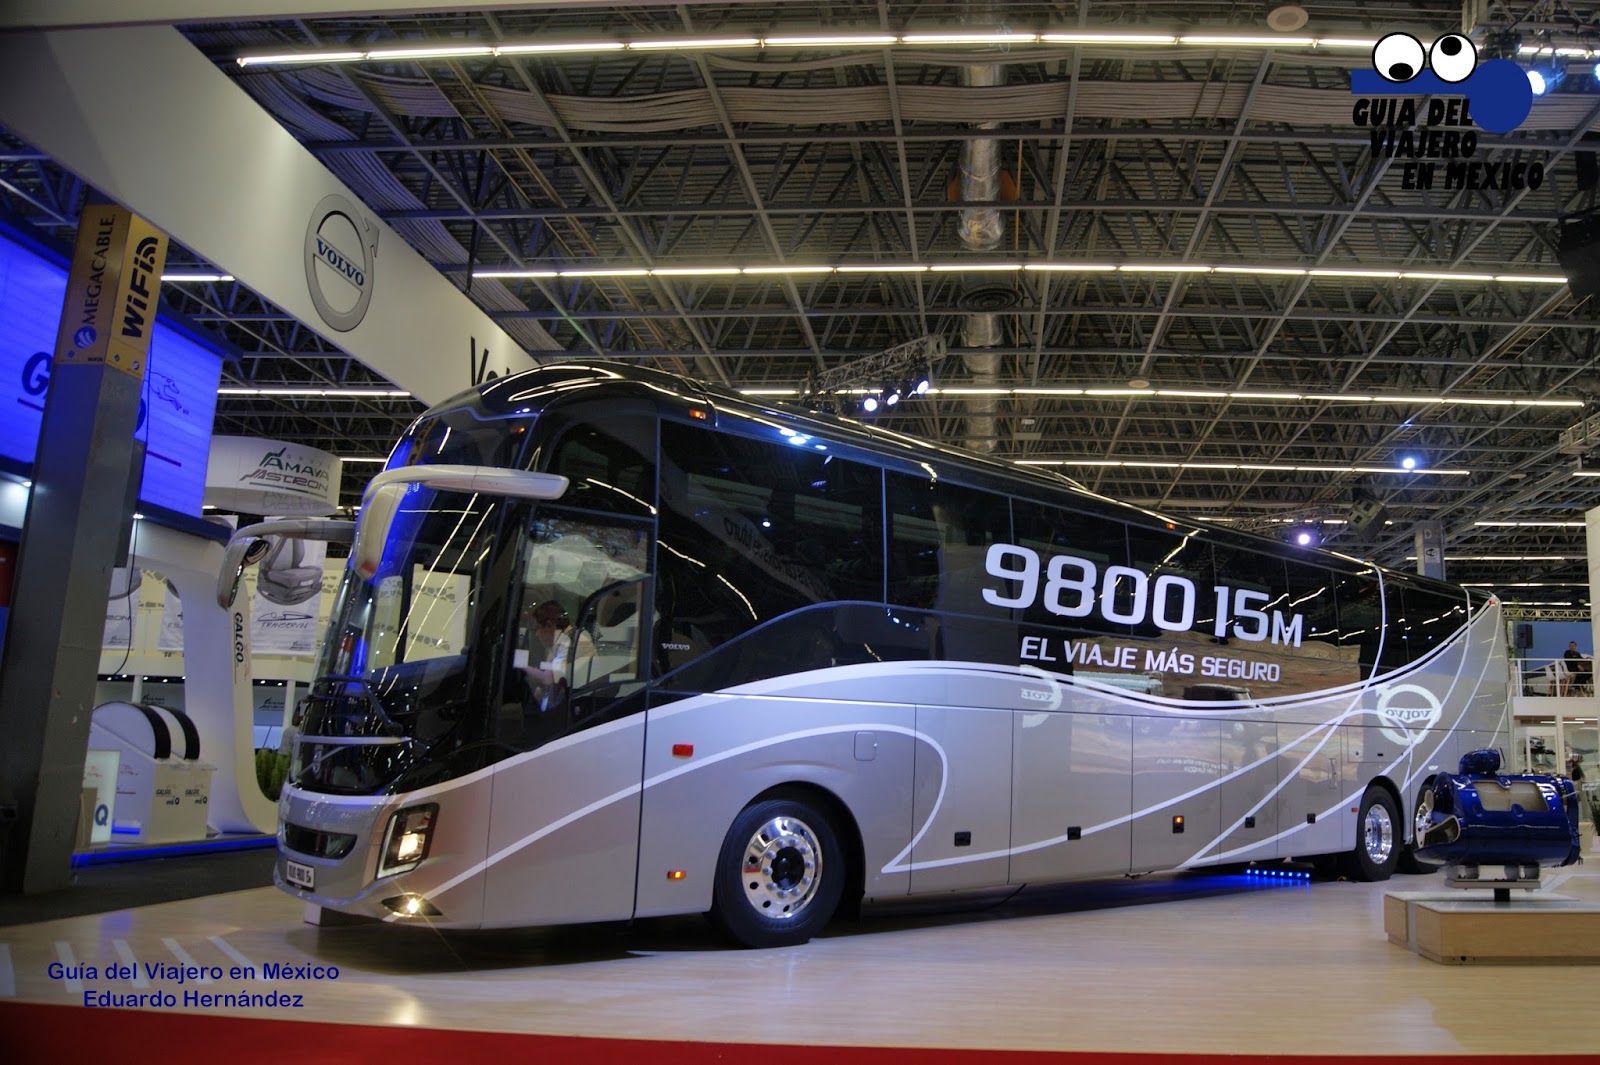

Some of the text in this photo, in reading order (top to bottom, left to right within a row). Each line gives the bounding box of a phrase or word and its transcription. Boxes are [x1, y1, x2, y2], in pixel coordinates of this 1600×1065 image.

[82, 214, 115, 325] MEGACABLE
[316, 238, 365, 287] VOLVO
[252, 469, 330, 492] ASTRON
[259, 455, 330, 482] AMAYA
[982, 543, 1303, 648] 9800 15M
[235, 611, 244, 663] GALGO
[1020, 636, 1281, 683] EL VIAJE MÁS SEGURO
[95, 804, 109, 826] Q
